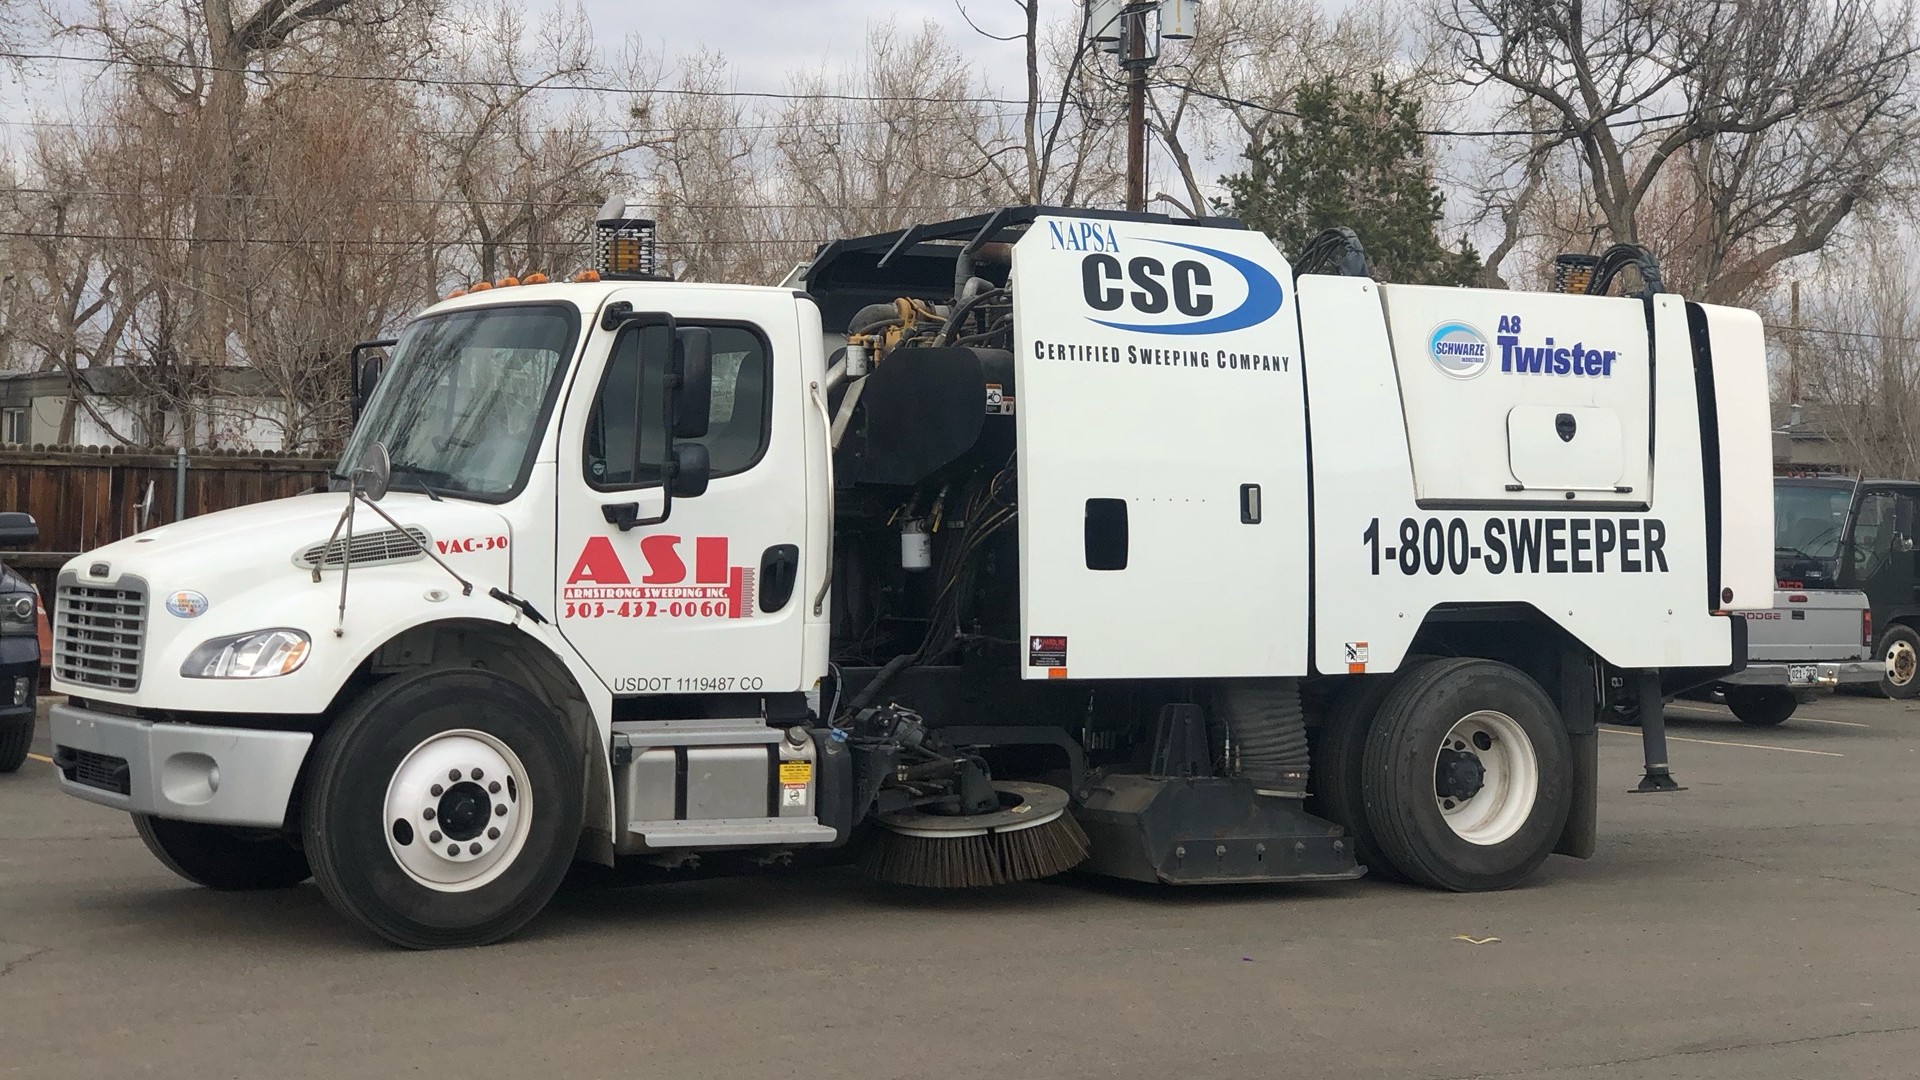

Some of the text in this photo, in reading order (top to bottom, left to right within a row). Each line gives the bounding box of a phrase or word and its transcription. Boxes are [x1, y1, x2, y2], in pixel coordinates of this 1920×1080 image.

[1048, 220, 1120, 253] NAPSA
[1081, 254, 1214, 317] CSC
[1497, 315, 1521, 334] A8
[1034, 339, 1290, 373] CERTIFIED SWEEPING COMPANY
[1435, 341, 1485, 356] SCHWARZE
[1497, 335, 1617, 377] Twister
[436, 536, 508, 554] VAC-30
[1363, 516, 1669, 576] 1-800-SWEEPER
[566, 535, 729, 585] ASI
[566, 587, 728, 599] ARMSTRONG SWEEPING INC.
[564, 601, 727, 619] 303-432-0060
[614, 676, 764, 692] USDOT 1119487 CO
